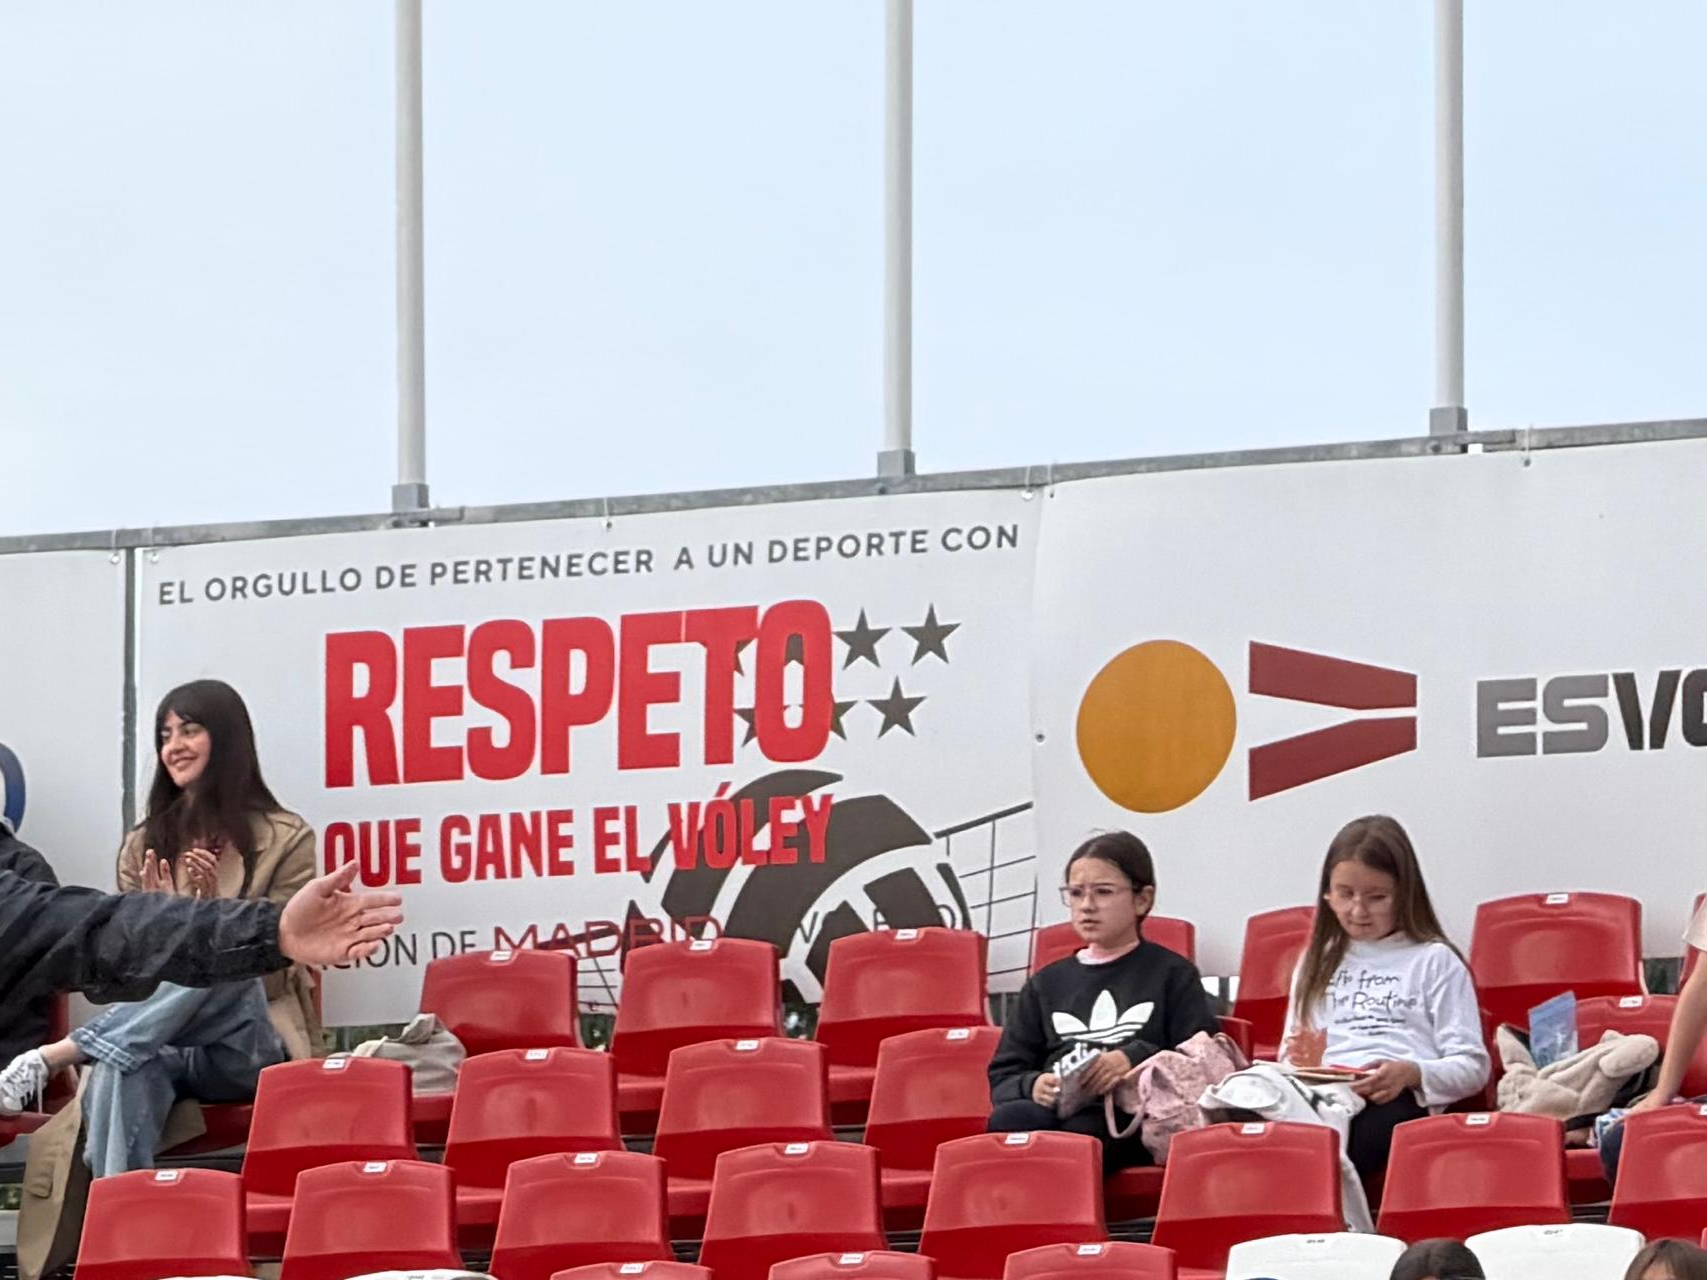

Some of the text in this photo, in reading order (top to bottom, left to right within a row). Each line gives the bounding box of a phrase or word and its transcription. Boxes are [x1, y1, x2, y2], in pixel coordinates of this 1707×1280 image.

[159, 524, 1018, 605] EL ORGULLO DE PERTENECER A UN DEPORTE CON
[325, 599, 833, 789] RESPETO
[324, 781, 835, 887] QUE GANE EL VÓLEY
[432, 931, 477, 960] DE
